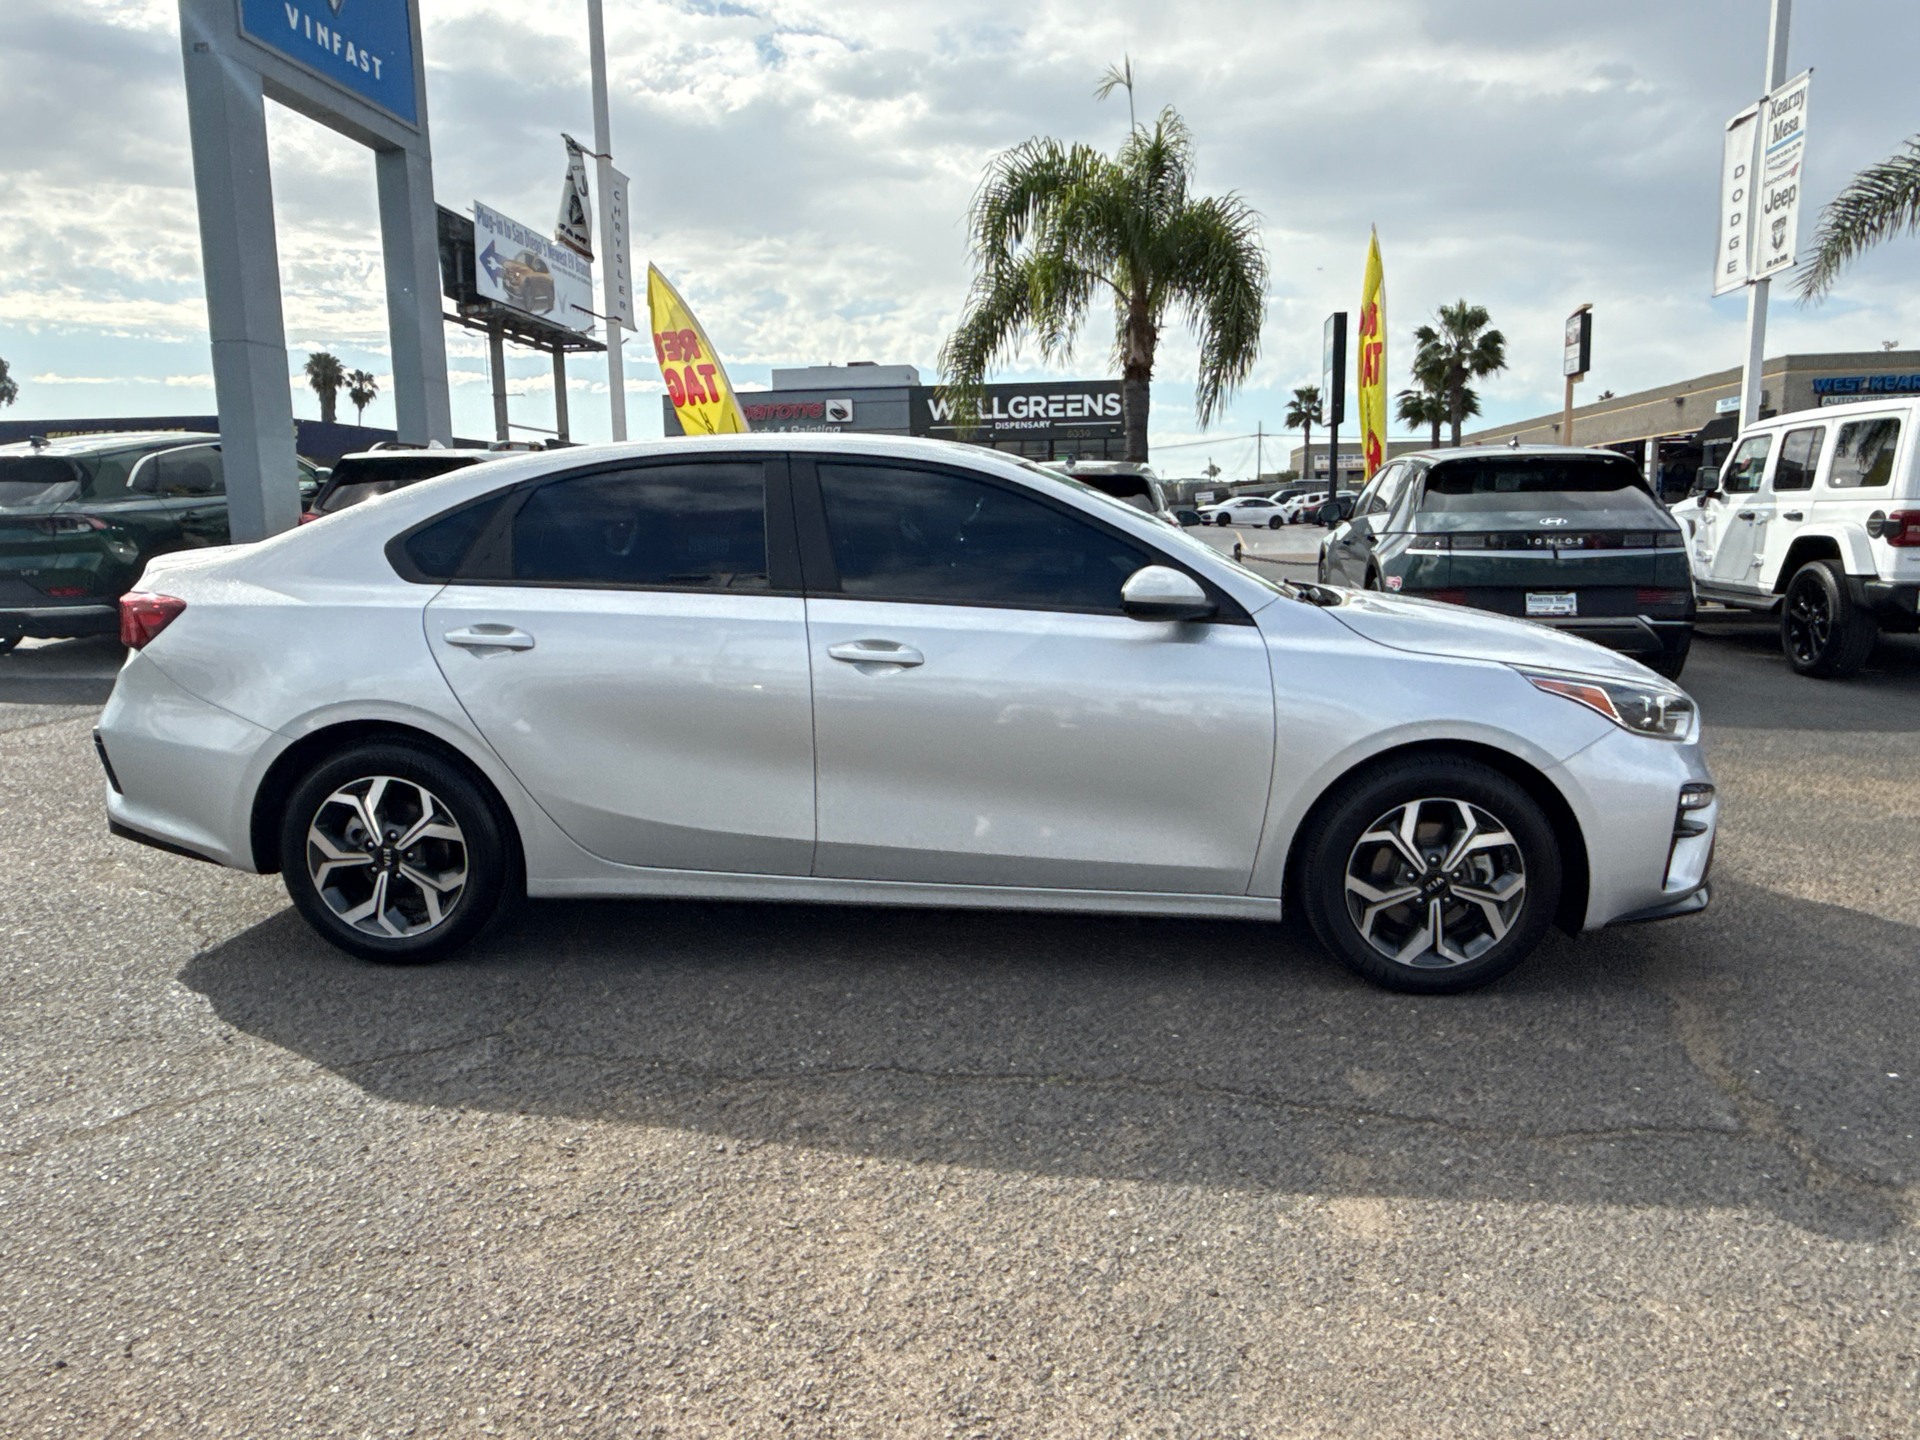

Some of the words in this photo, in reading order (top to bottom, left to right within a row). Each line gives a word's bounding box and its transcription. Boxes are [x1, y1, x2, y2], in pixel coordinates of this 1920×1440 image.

[285, 2, 382, 80] VINFAST
[1769, 86, 1807, 121] Kearny
[1772, 115, 1800, 144] Mesa
[1766, 141, 1802, 165] CHRYSLER
[1764, 183, 1797, 214] Jeep
[1726, 164, 1746, 275] DODGE
[512, 223, 525, 246] San
[612, 190, 627, 312] CHRYSLER
[1766, 253, 1788, 268] RAM
[1813, 377, 1867, 393] WEST
[994, 420, 1051, 430] DISPENSARY
[383, 847, 392, 867] KIA
[1425, 877, 1445, 892] KIA
